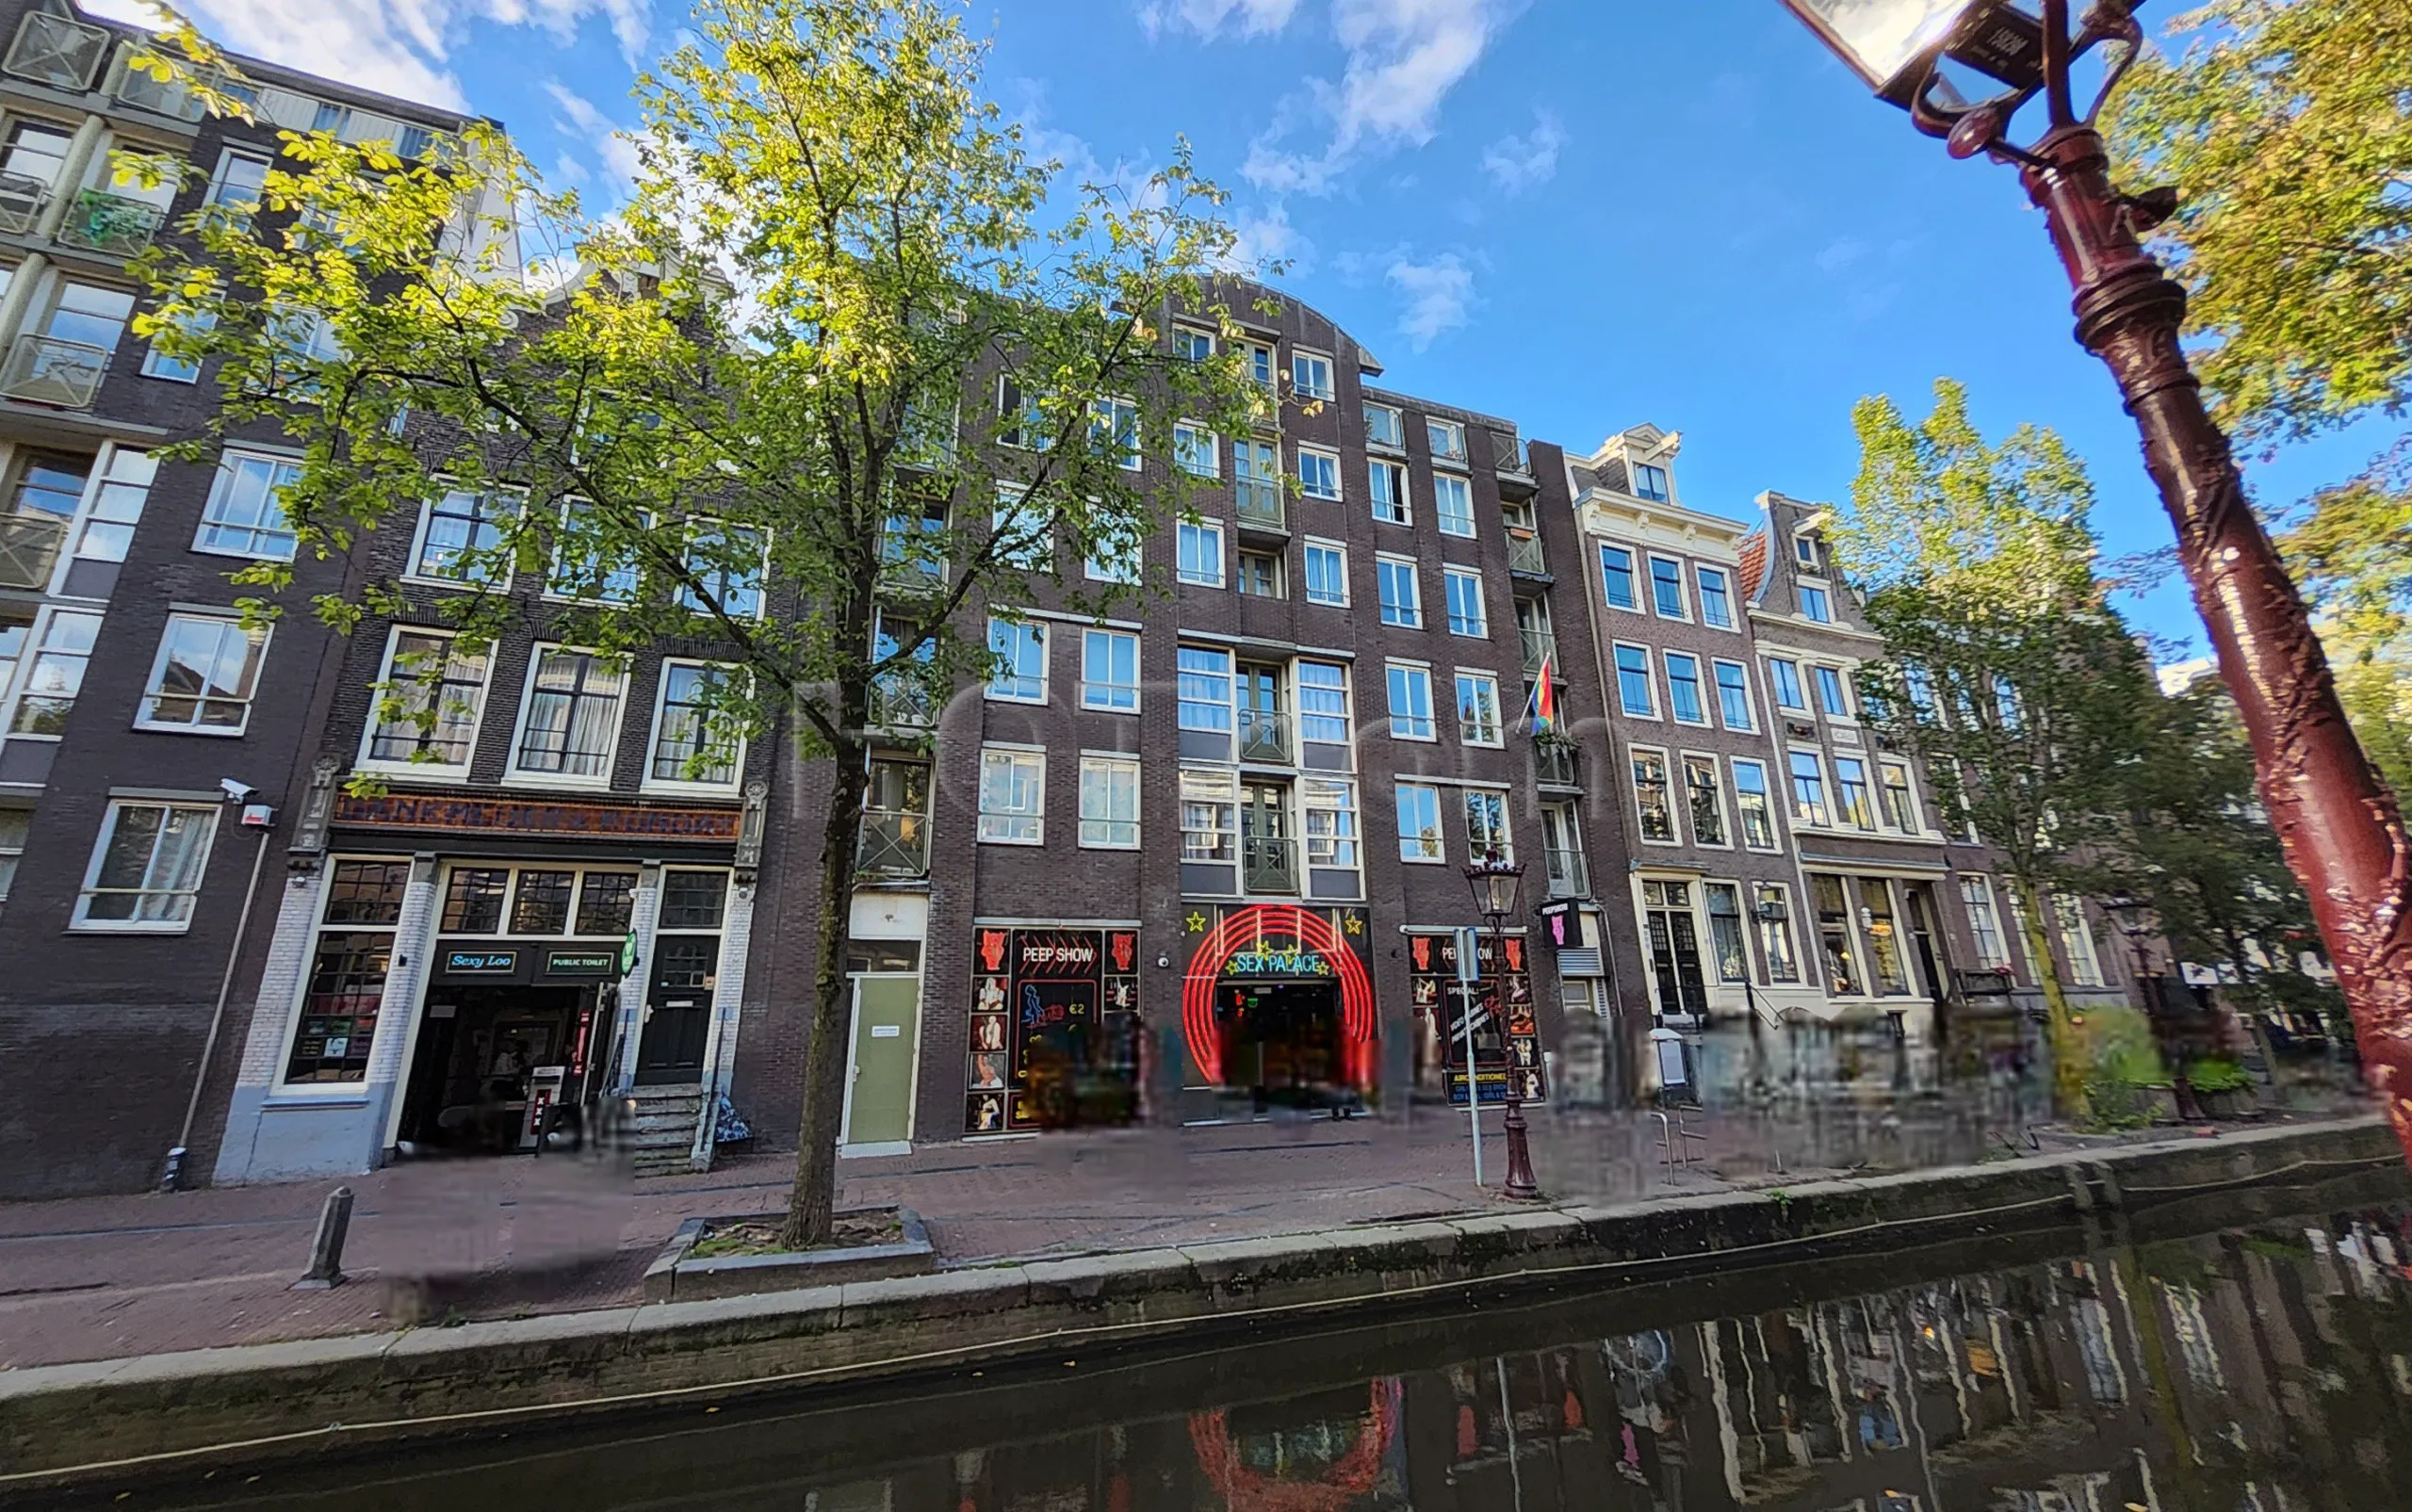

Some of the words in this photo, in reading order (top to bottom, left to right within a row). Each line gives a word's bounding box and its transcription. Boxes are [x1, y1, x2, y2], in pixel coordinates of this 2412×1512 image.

[1023, 947, 1053, 962] PEEP
[1056, 948, 1094, 962] SHOW
[1477, 947, 1492, 960] OW
[451, 954, 483, 968] Sexy
[487, 955, 512, 966] Loo
[1236, 955, 1263, 972] SEX
[1268, 954, 1319, 972] PALACE
[1447, 986, 1479, 995] SPECAL:
[1068, 1003, 1084, 1015] €2
